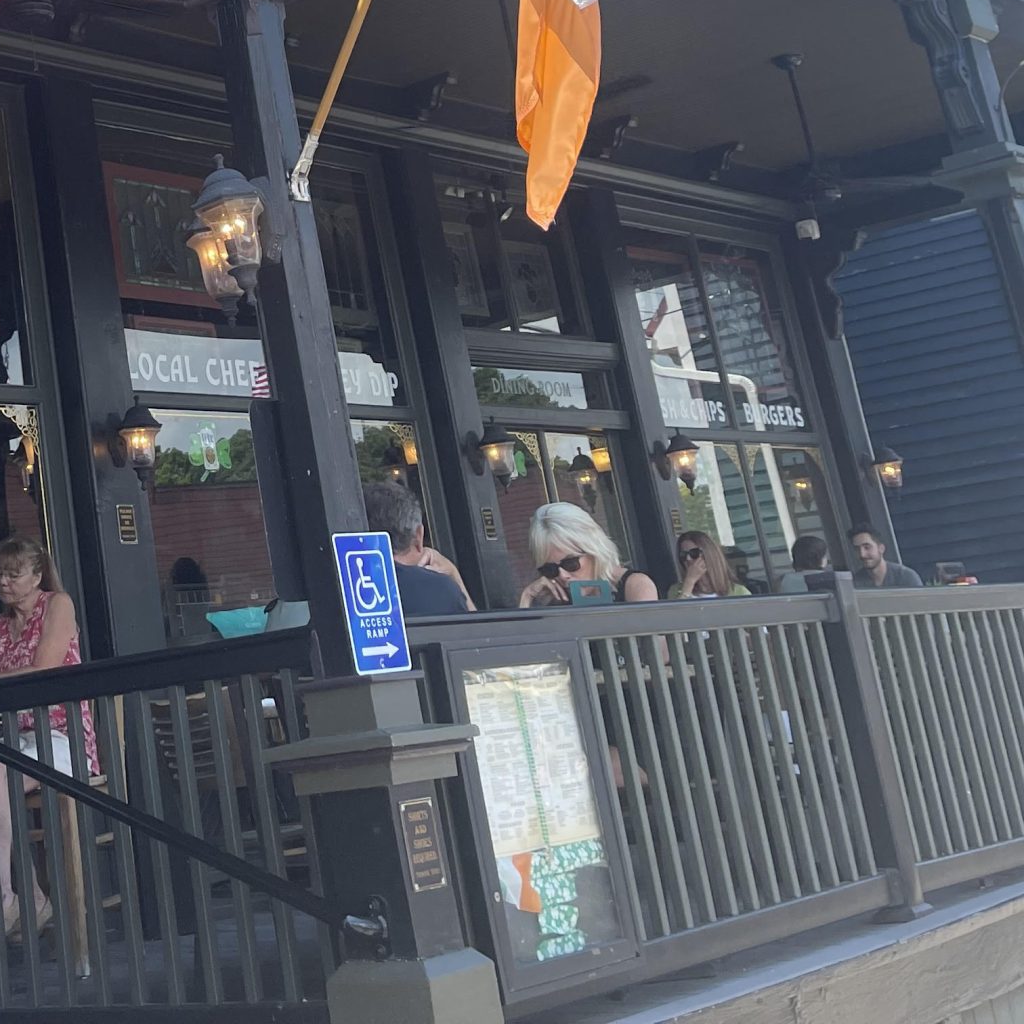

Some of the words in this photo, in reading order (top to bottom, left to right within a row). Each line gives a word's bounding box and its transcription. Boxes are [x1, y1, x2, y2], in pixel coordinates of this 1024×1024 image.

[129, 352, 199, 384] LOCAL
[370, 370, 399, 398] DIP
[491, 377, 535, 396] DINING
[536, 381, 572, 397] ROOM
[690, 398, 726, 423] CHIPS
[743, 403, 805, 427] BURGERS
[360, 617, 393, 628] ACCESS
[366, 628, 389, 639] RAMP
